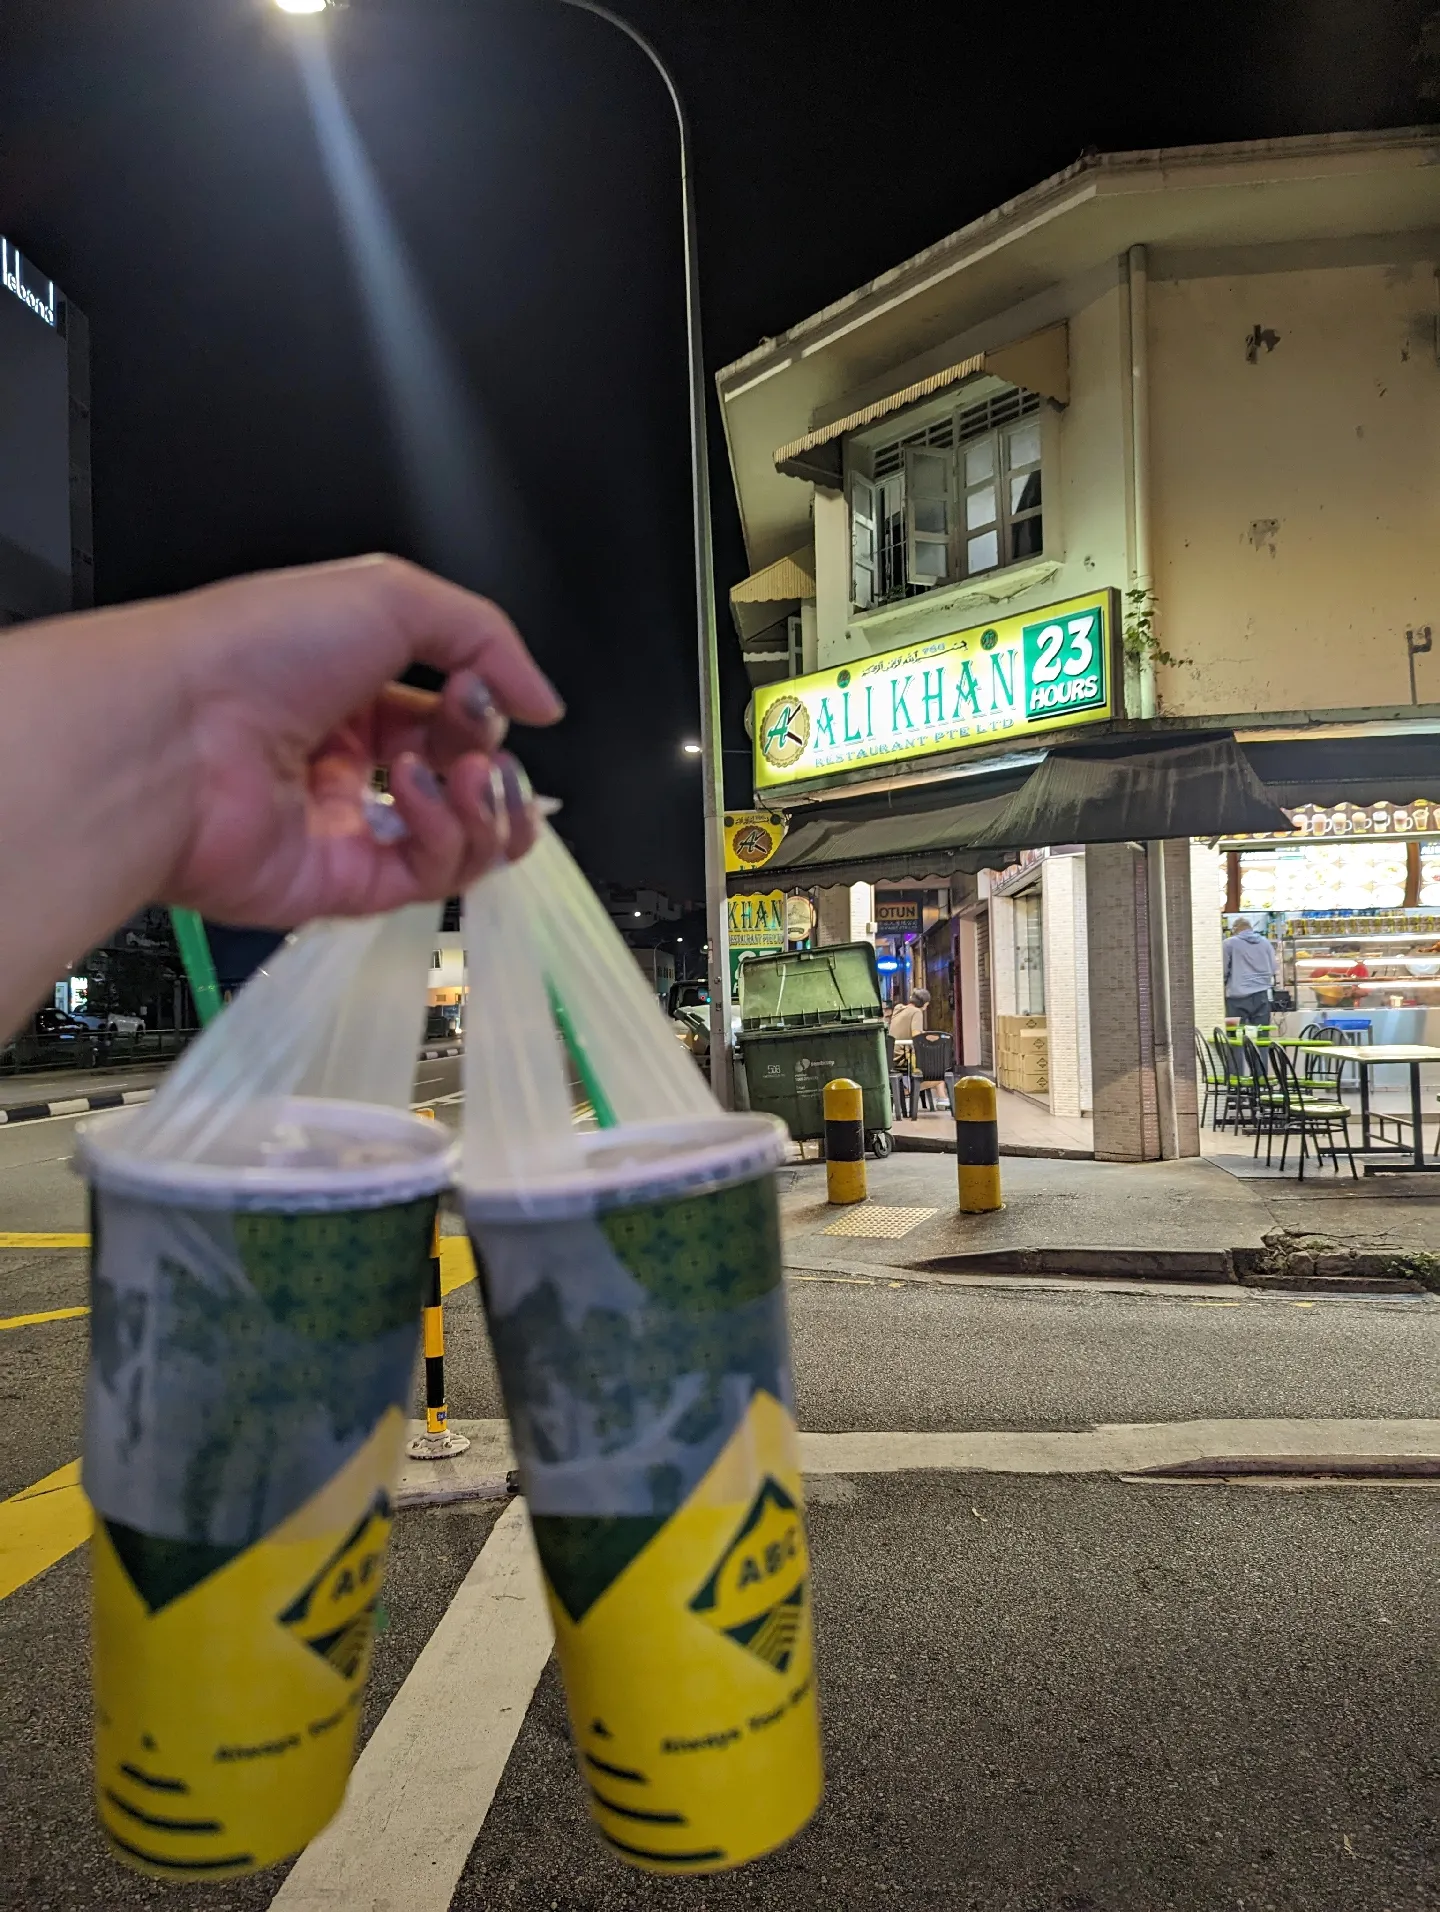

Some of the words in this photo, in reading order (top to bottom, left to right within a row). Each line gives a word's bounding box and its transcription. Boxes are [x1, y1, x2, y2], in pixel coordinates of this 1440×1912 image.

[1032, 615, 1094, 685] 23
[814, 685, 875, 749] ALI
[891, 648, 1016, 732] KHAN
[1030, 674, 1098, 711] HOURS
[815, 735, 928, 768] RESTAURANT
[935, 726, 971, 743] PTE
[976, 718, 1015, 735] LTD
[727, 899, 783, 930] KHAN
